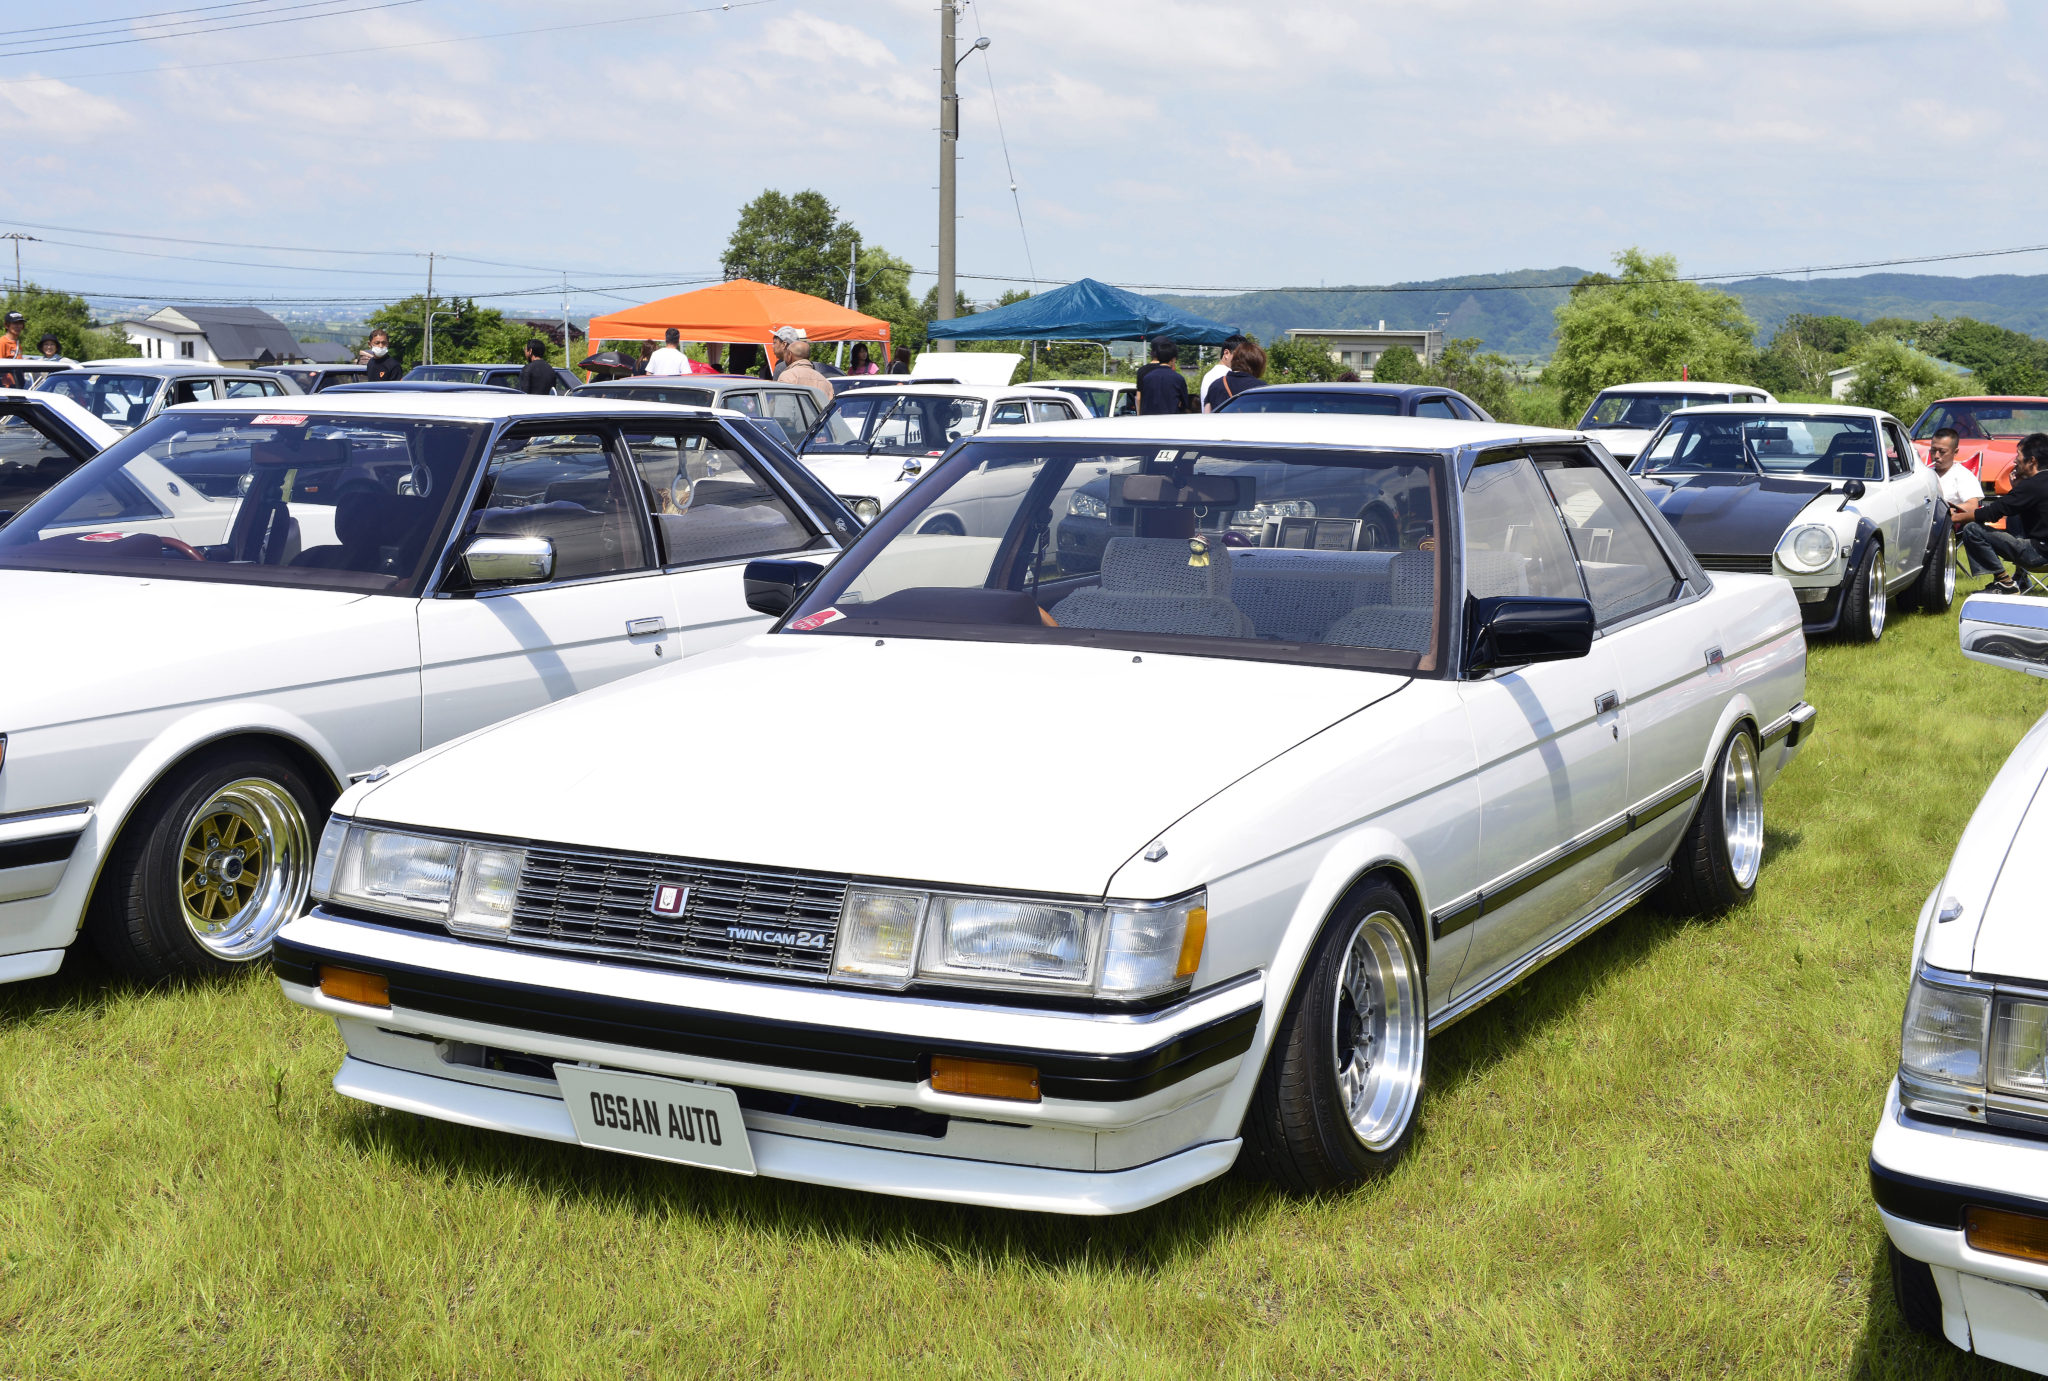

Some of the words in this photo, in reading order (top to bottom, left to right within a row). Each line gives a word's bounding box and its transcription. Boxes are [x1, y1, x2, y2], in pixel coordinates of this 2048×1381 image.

[796, 931, 825, 949] 24
[590, 1091, 662, 1137] OSSAN
[668, 1103, 722, 1147] AUTO
